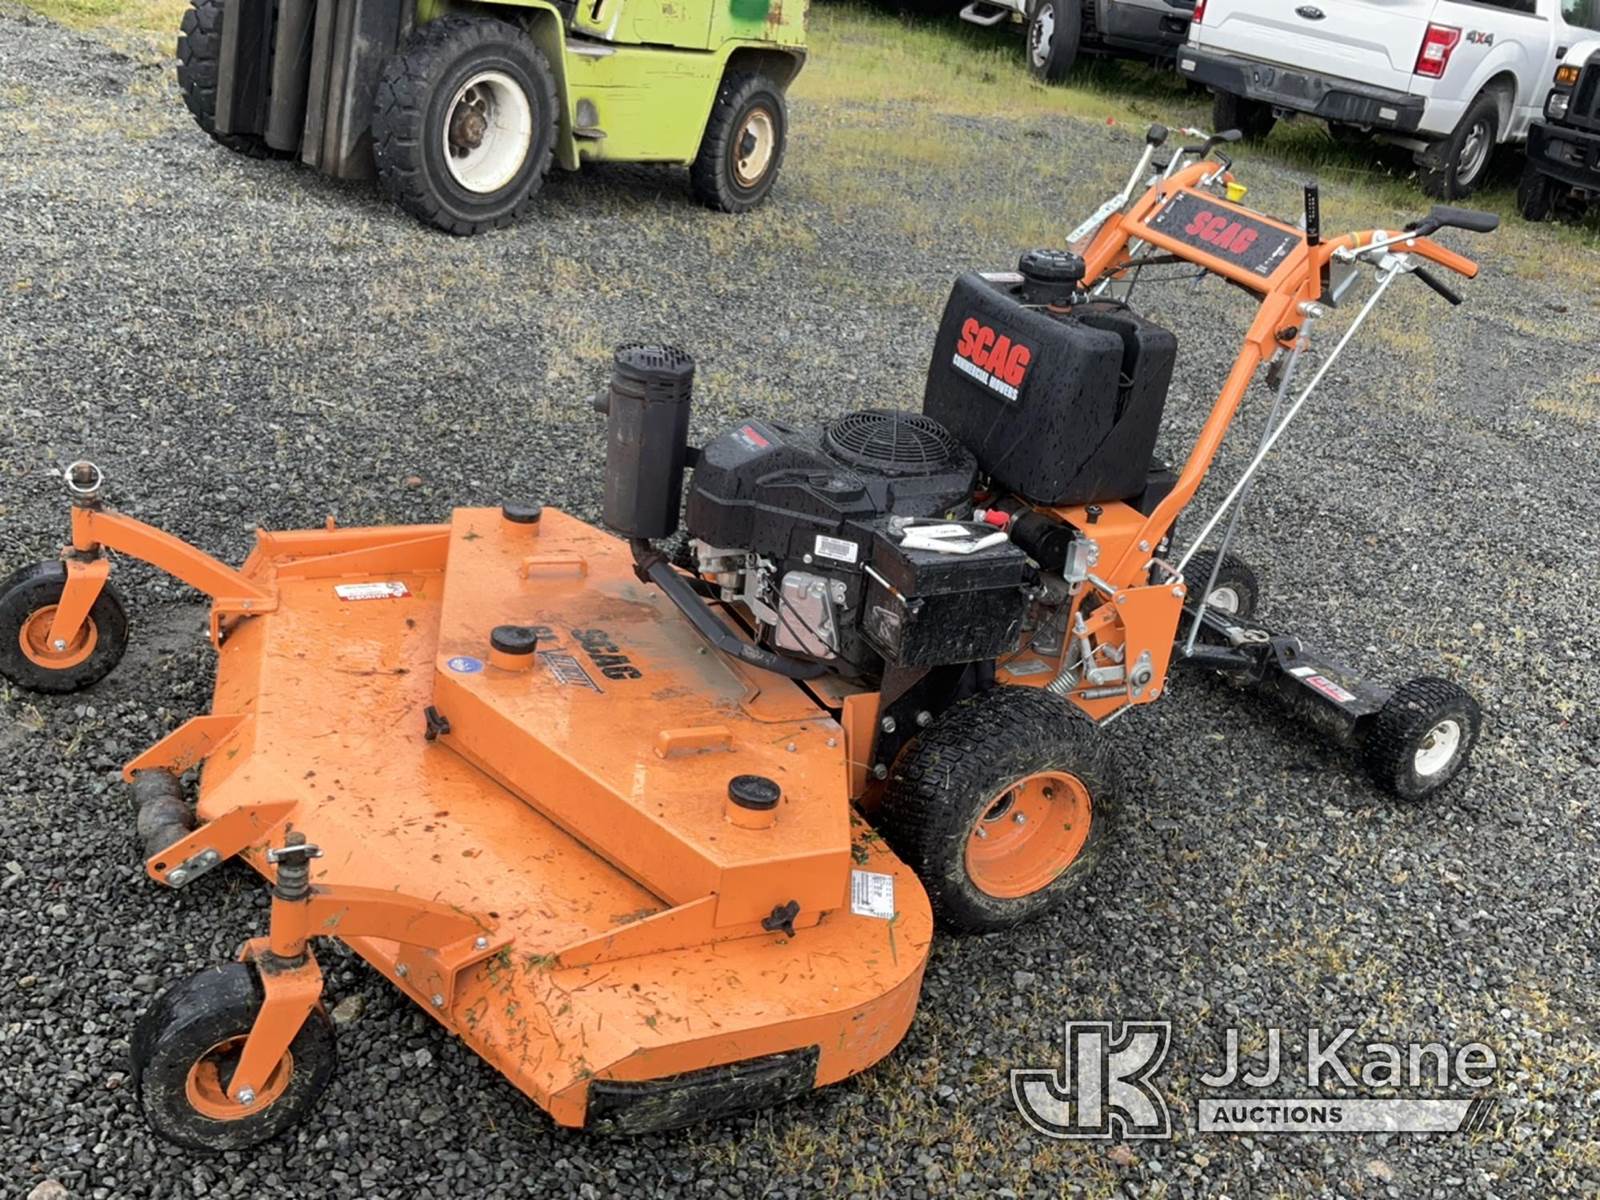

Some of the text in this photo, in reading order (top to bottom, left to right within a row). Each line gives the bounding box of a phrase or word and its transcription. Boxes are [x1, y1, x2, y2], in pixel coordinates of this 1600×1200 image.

[1185, 210, 1258, 254] SCAG
[957, 318, 1031, 385] SCAG
[571, 628, 642, 680] SCAG
